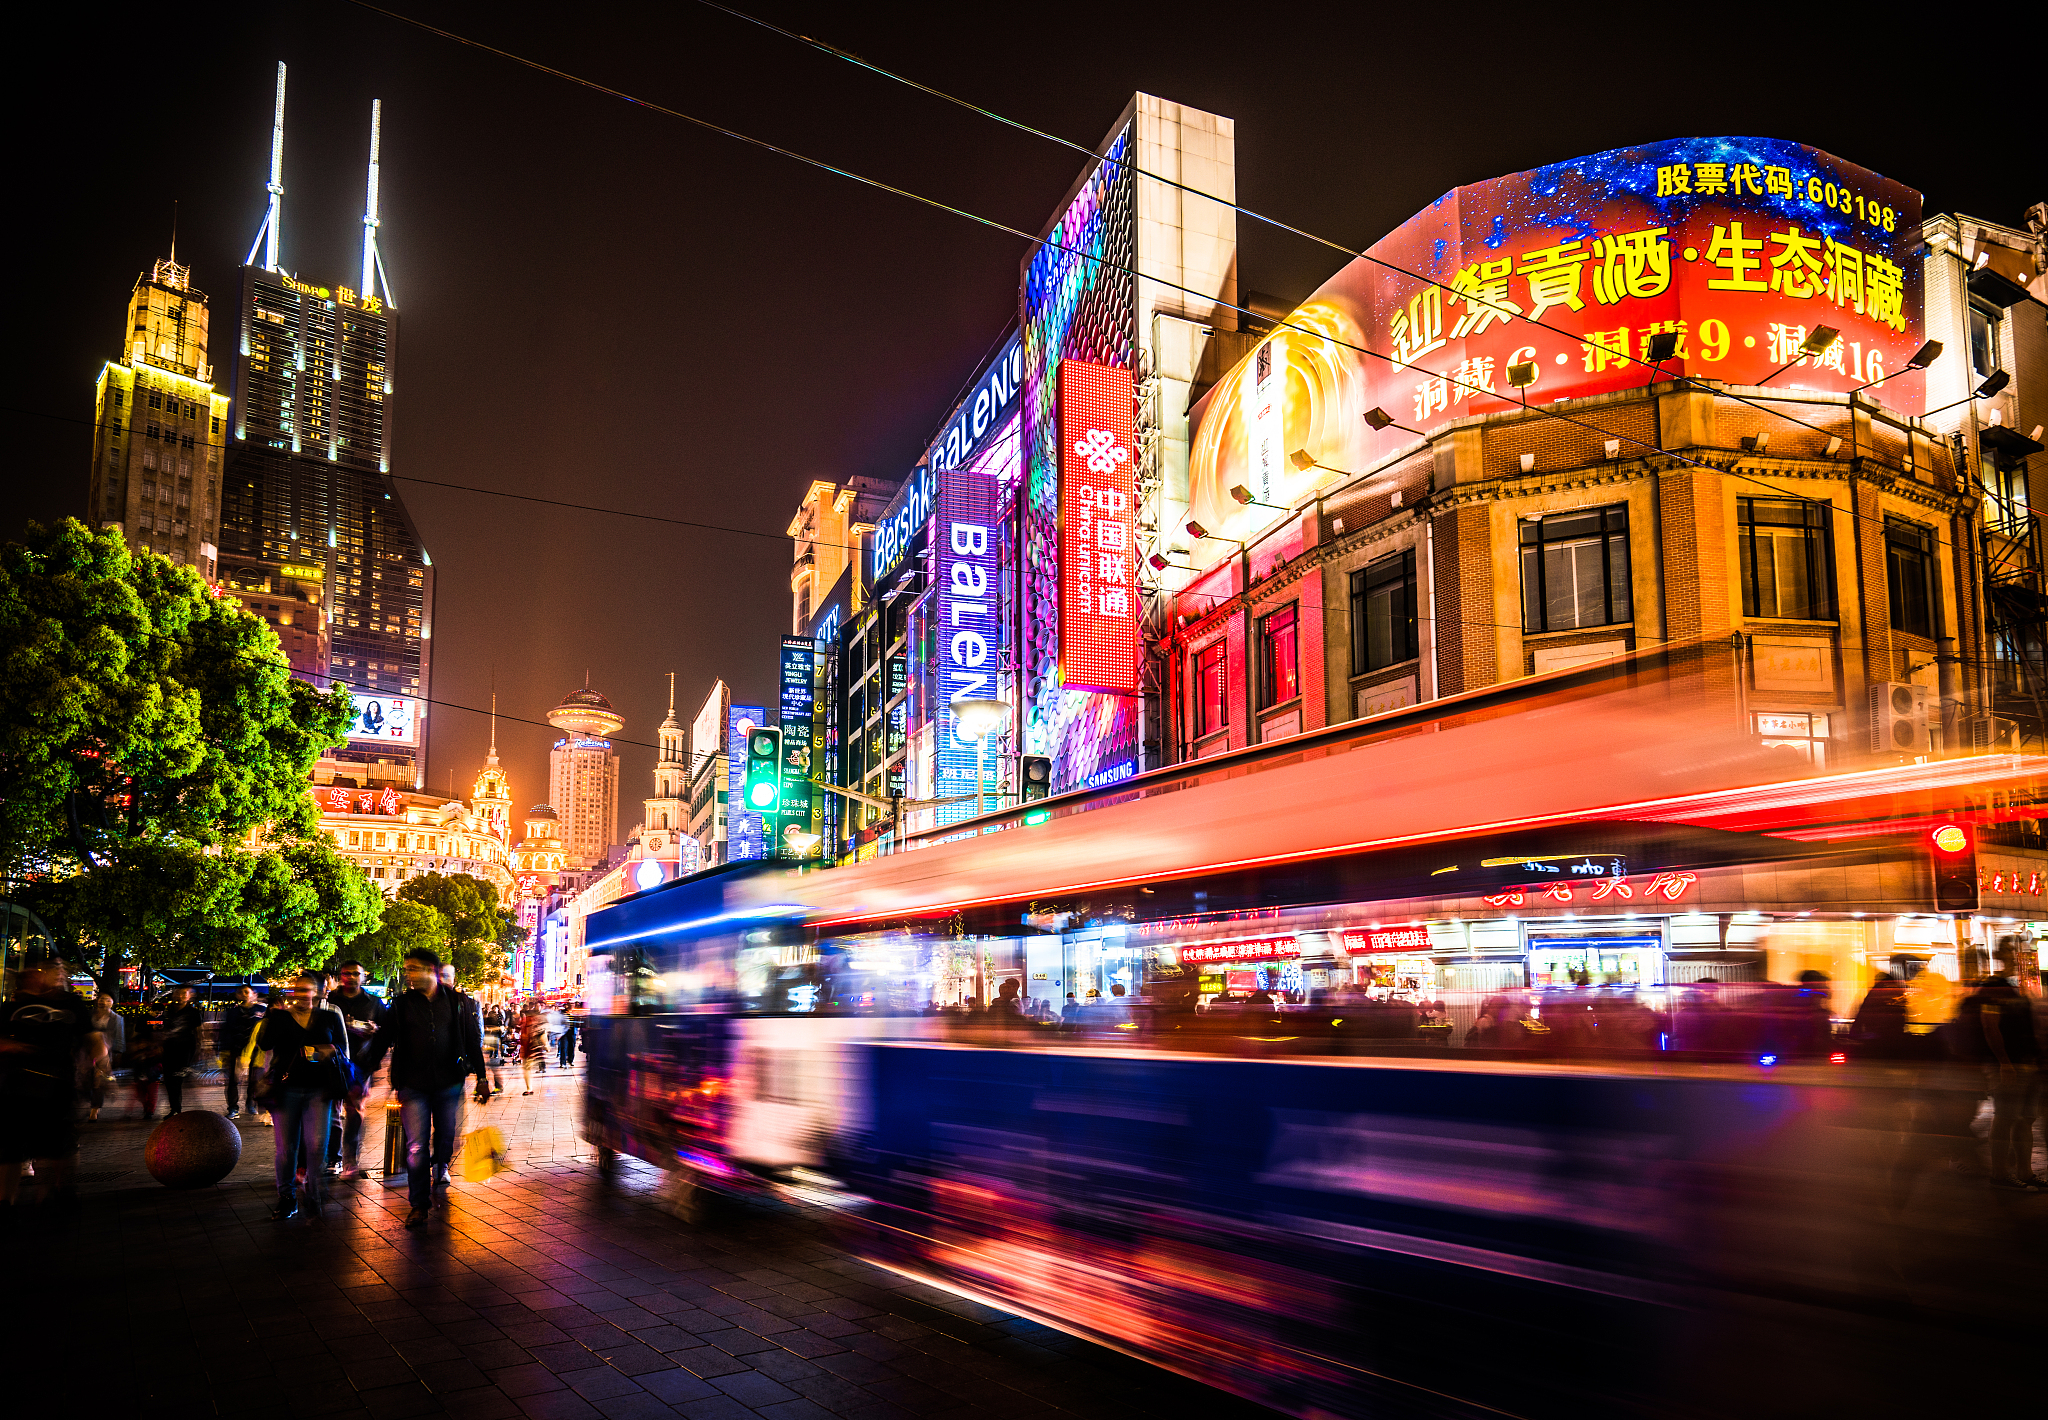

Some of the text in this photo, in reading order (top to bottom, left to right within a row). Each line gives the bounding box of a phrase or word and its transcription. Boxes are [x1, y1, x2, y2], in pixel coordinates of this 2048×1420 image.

[1656, 163, 1895, 233] 股票代码:603198
[335, 284, 383, 315] 世茂
[1096, 487, 1128, 617] 中国联通
[816, 665, 825, 677] 7
[814, 700, 825, 713] 6
[783, 724, 810, 738] 陶瓷
[814, 735, 824, 748] 5
[813, 771, 823, 782] 4
[1088, 761, 1133, 789] SAMSUNG
[812, 807, 823, 820] 3
[811, 844, 822, 857] 2
